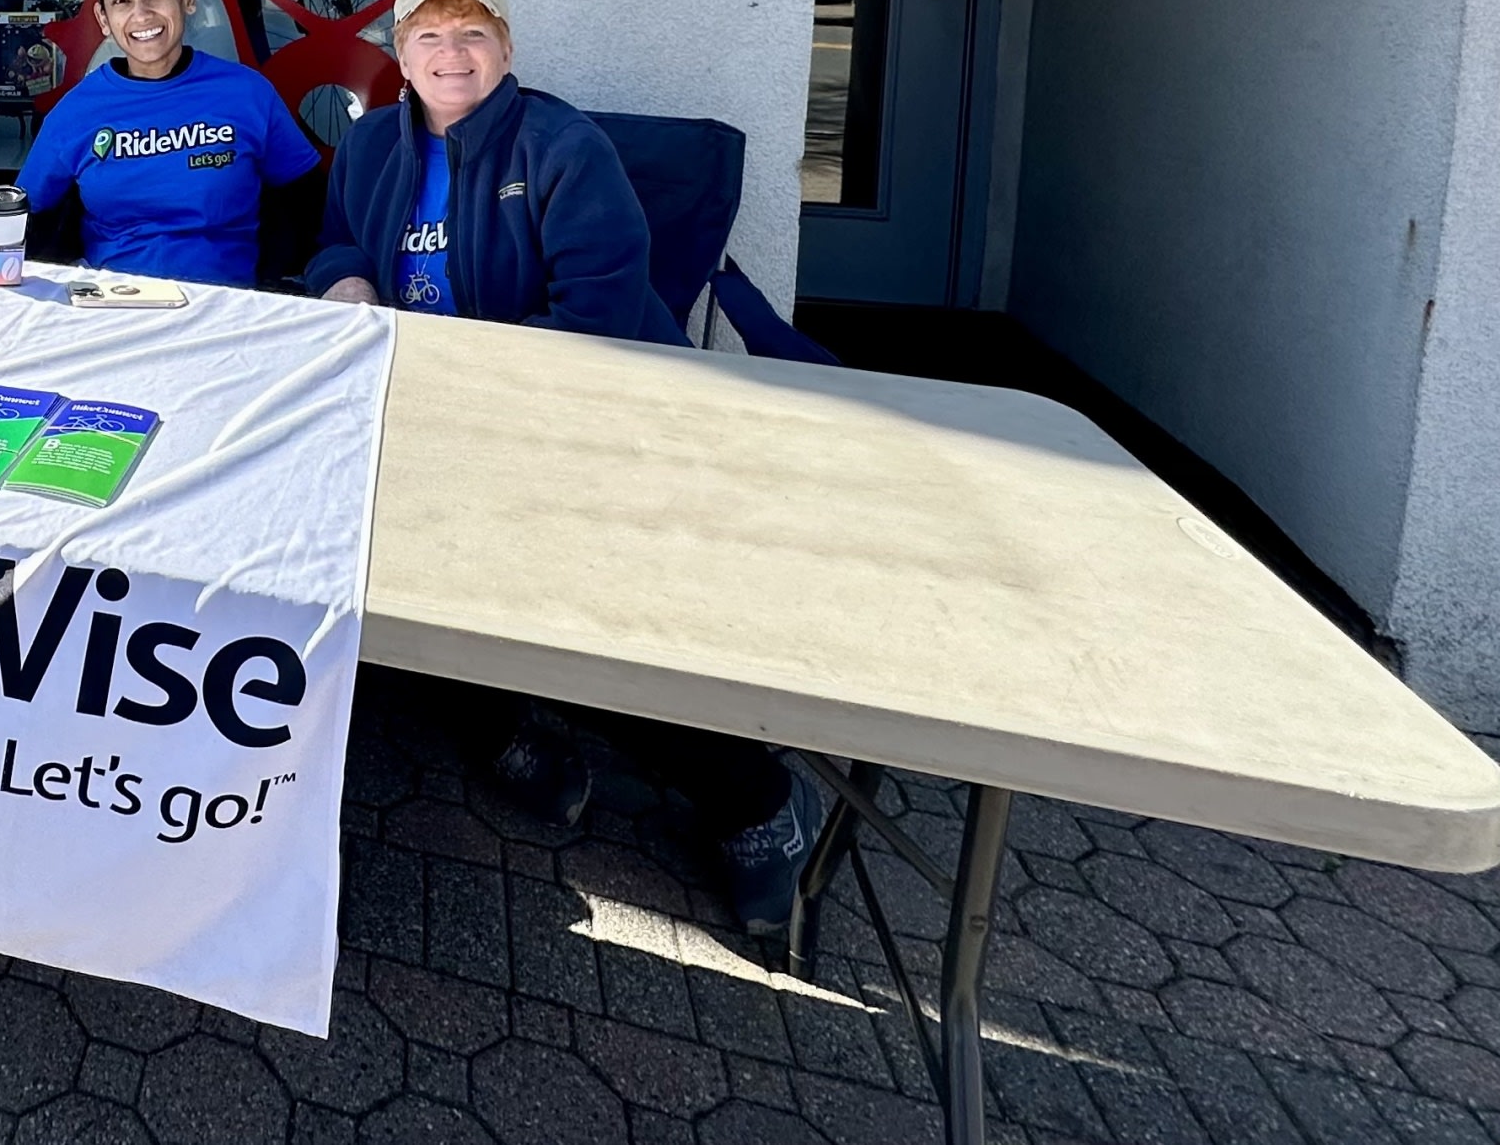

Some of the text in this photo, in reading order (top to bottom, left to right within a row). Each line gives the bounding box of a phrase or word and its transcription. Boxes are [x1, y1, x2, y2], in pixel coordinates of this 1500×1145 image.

[115, 122, 234, 157] RideWise
[189, 155, 213, 167] Let's
[71, 404, 145, 421] BikeConnect
[0, 739, 143, 818] Let's
